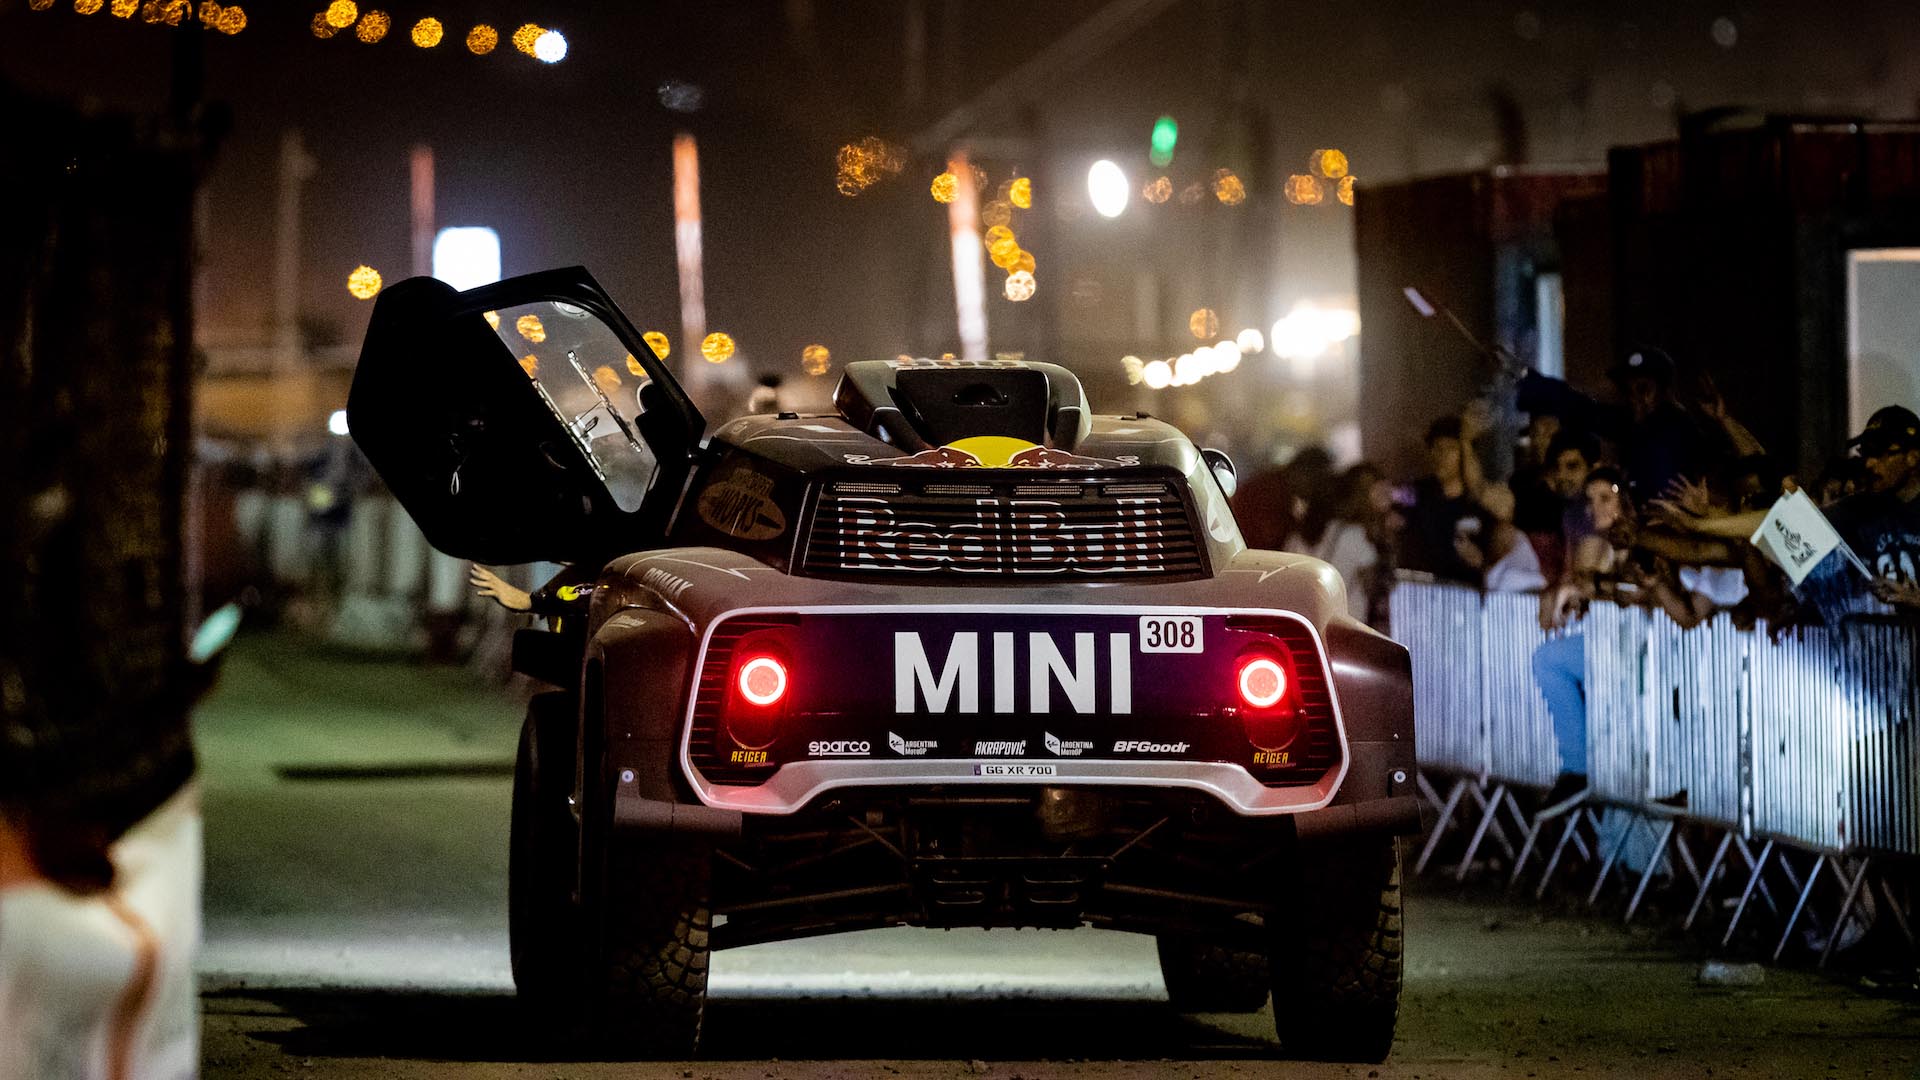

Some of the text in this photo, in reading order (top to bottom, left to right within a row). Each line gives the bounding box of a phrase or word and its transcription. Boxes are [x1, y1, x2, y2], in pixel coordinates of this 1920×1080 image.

[837, 497, 1165, 574] Red Bull
[1146, 620, 1196, 648] 308
[894, 631, 1132, 714] MINI
[808, 740, 871, 756] sparco
[904, 740, 938, 749] ARGENTINA
[1060, 740, 1094, 749] ARGENTINA
[1113, 741, 1190, 753] BFGoodr
[731, 751, 768, 763] REIGER
[904, 748, 928, 756] MotoGP
[1060, 748, 1083, 756] MotoGP
[1253, 752, 1289, 764] REIGER
[985, 766, 1052, 775] GG XR 700
